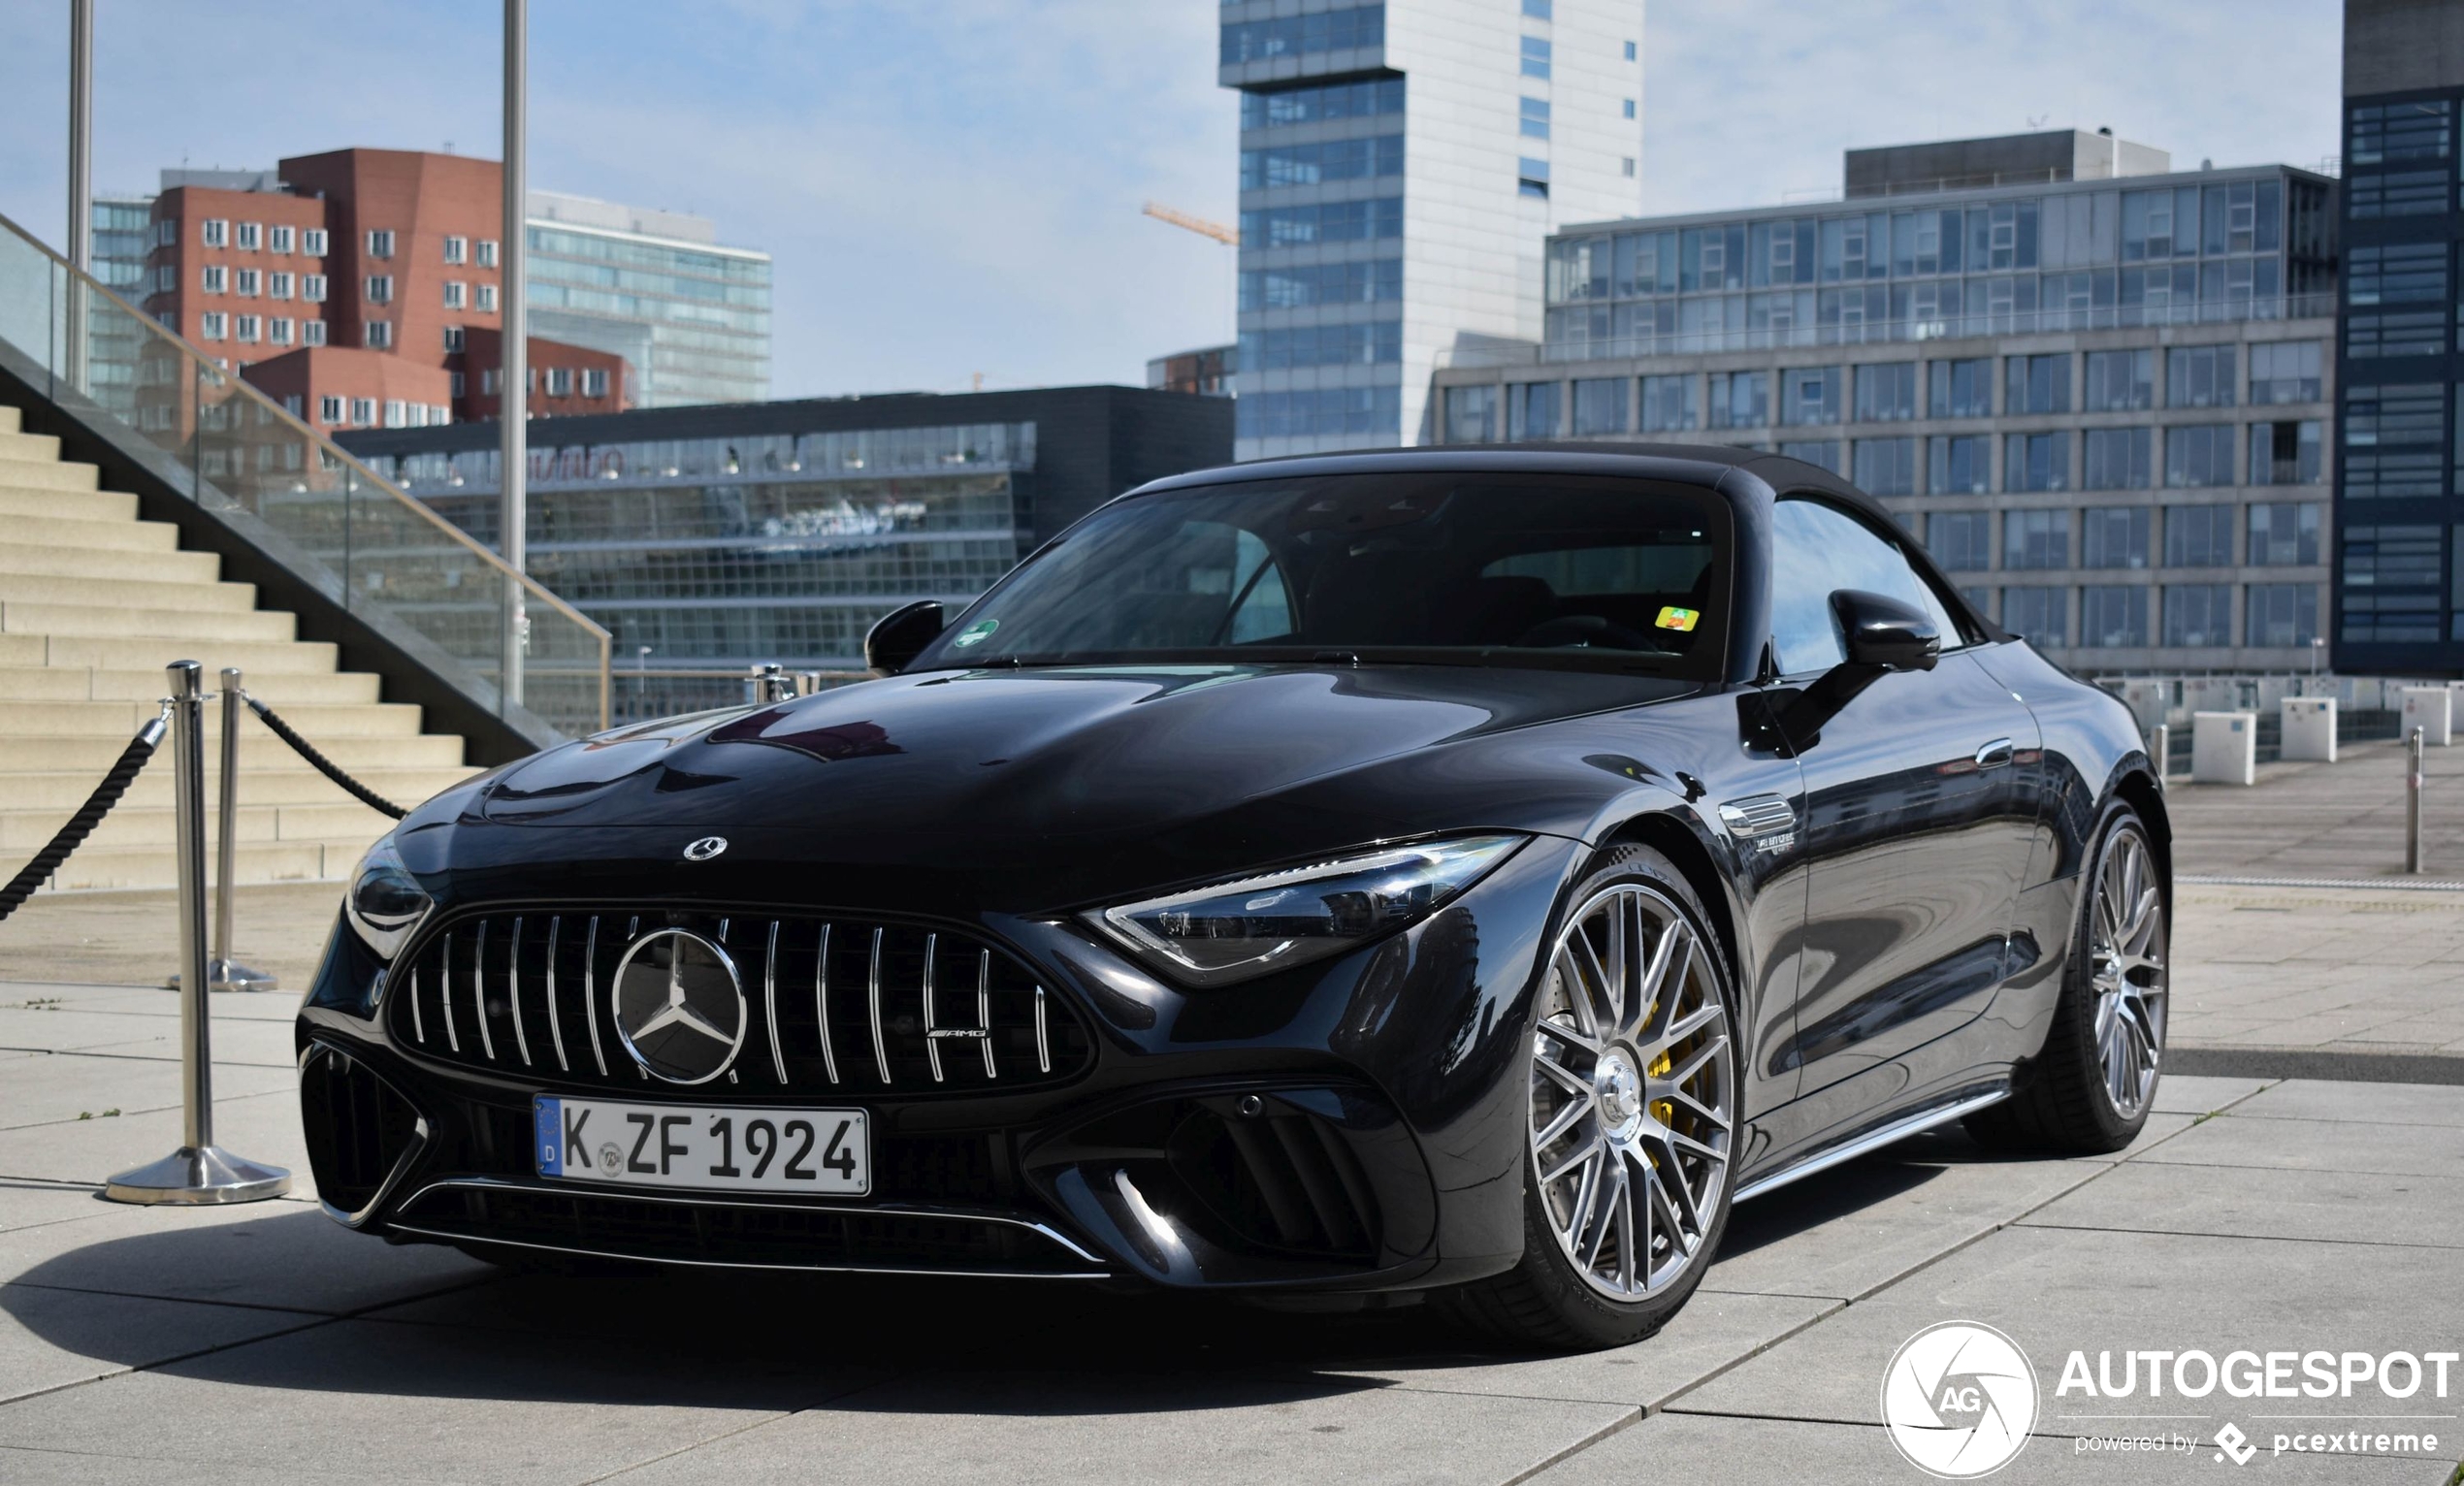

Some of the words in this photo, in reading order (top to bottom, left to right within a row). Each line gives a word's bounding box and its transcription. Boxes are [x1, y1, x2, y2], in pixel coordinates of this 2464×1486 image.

[545, 1145, 556, 1162] D
[564, 1107, 592, 1168] K
[627, 1113, 693, 1175] ZF
[709, 1116, 857, 1180] 1924
